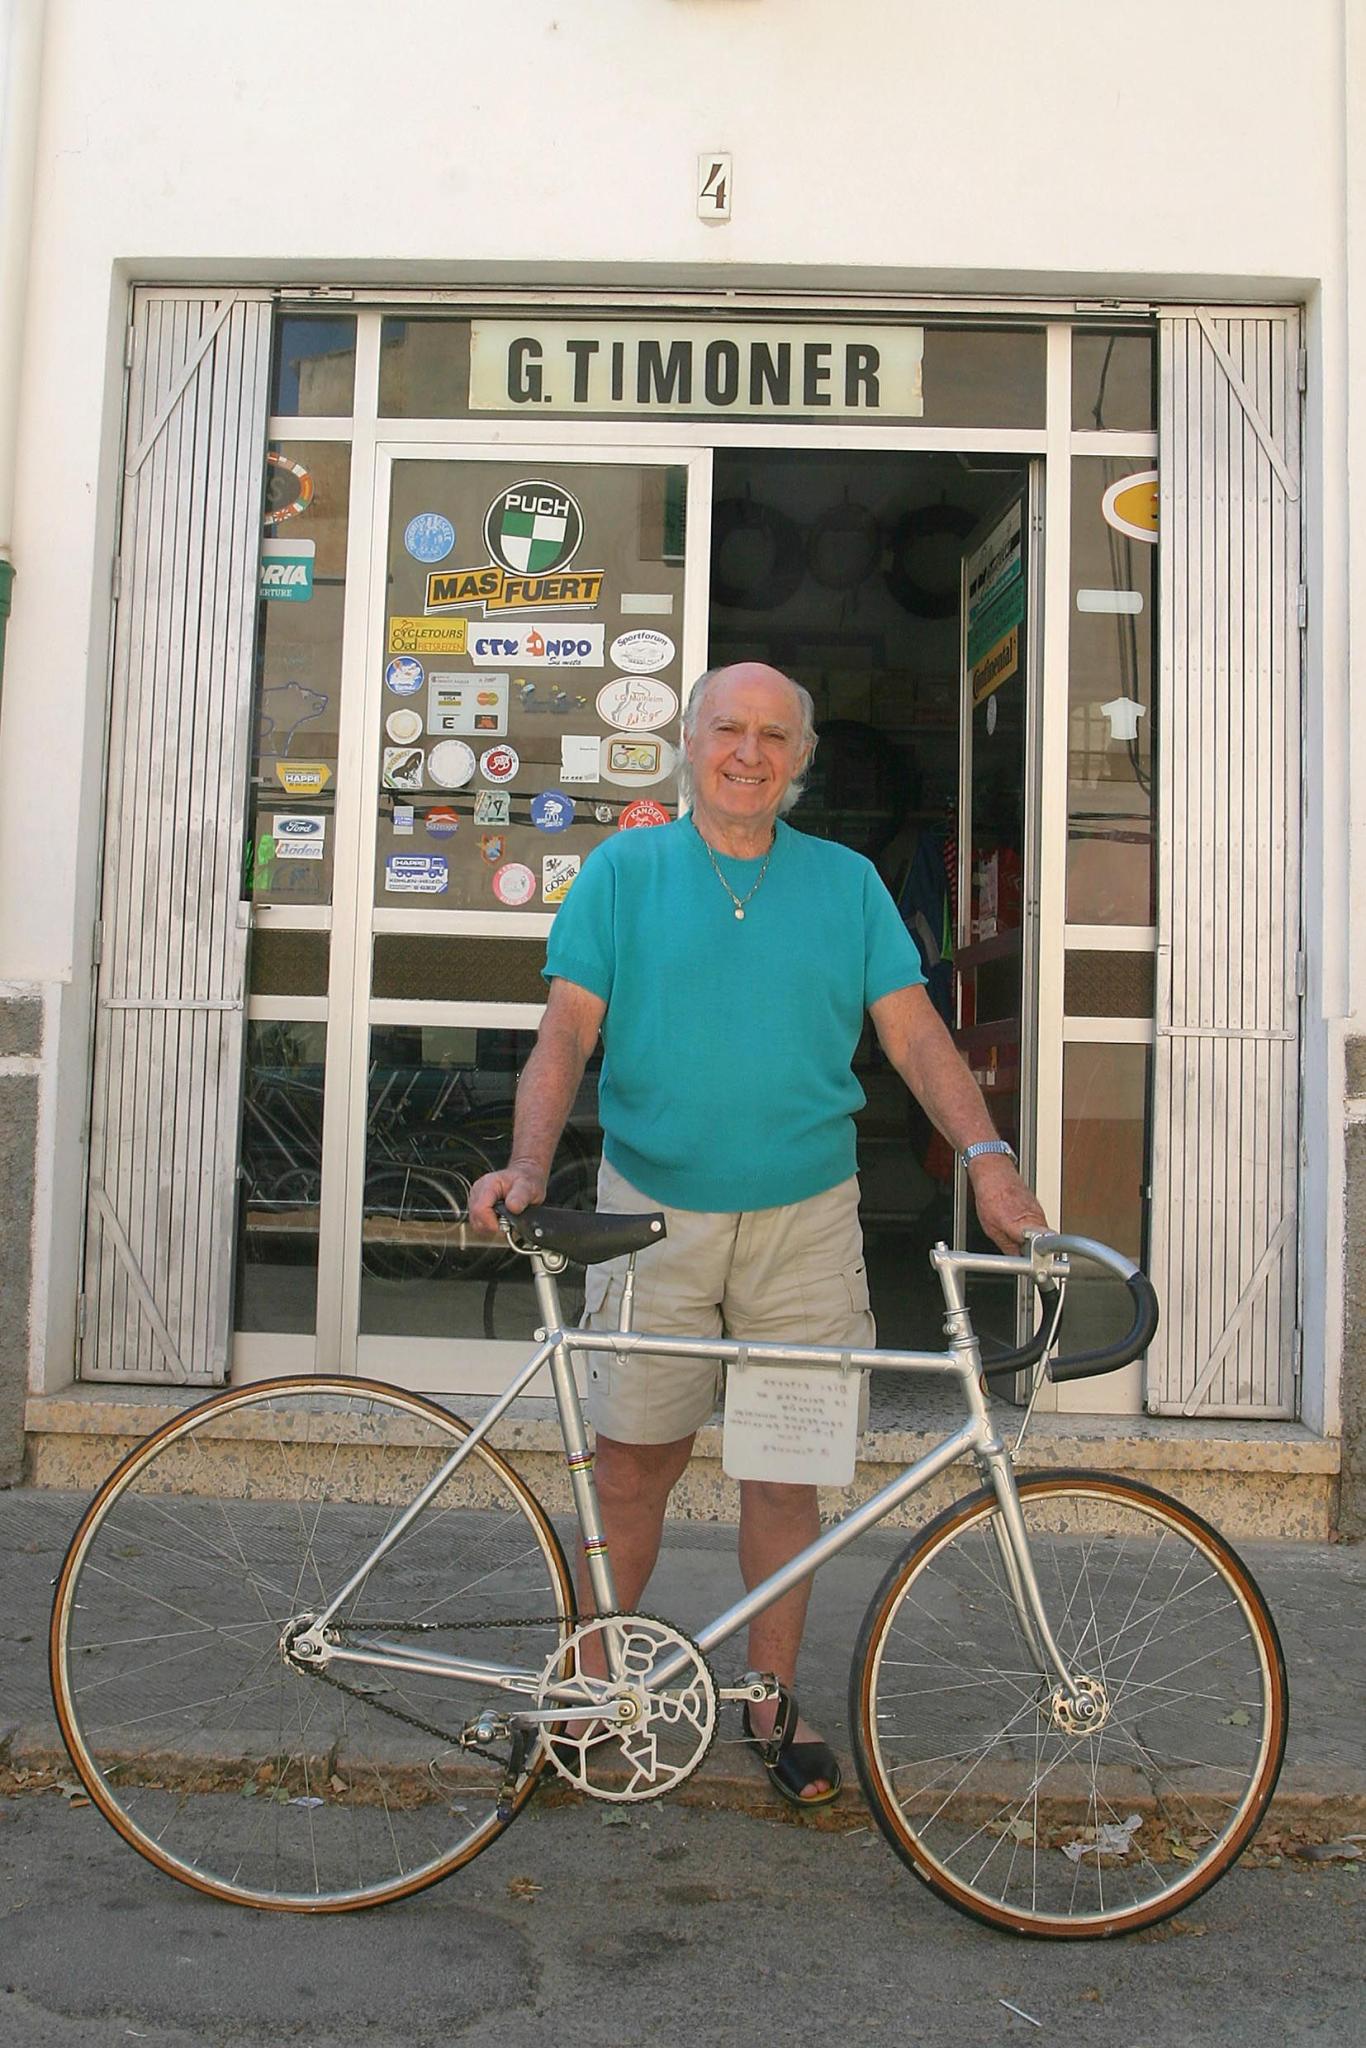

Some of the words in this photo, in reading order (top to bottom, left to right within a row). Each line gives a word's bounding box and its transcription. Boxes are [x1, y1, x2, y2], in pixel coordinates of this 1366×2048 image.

[699, 163, 727, 209] 4
[505, 494, 570, 517] PUCH
[433, 573, 499, 601] MAS
[505, 577, 602, 603] FUERT
[393, 627, 463, 638] CYCLETOURS
[617, 632, 668, 647] Sportforum
[972, 637, 1013, 700] Continental
[286, 820, 312, 832] Ford
